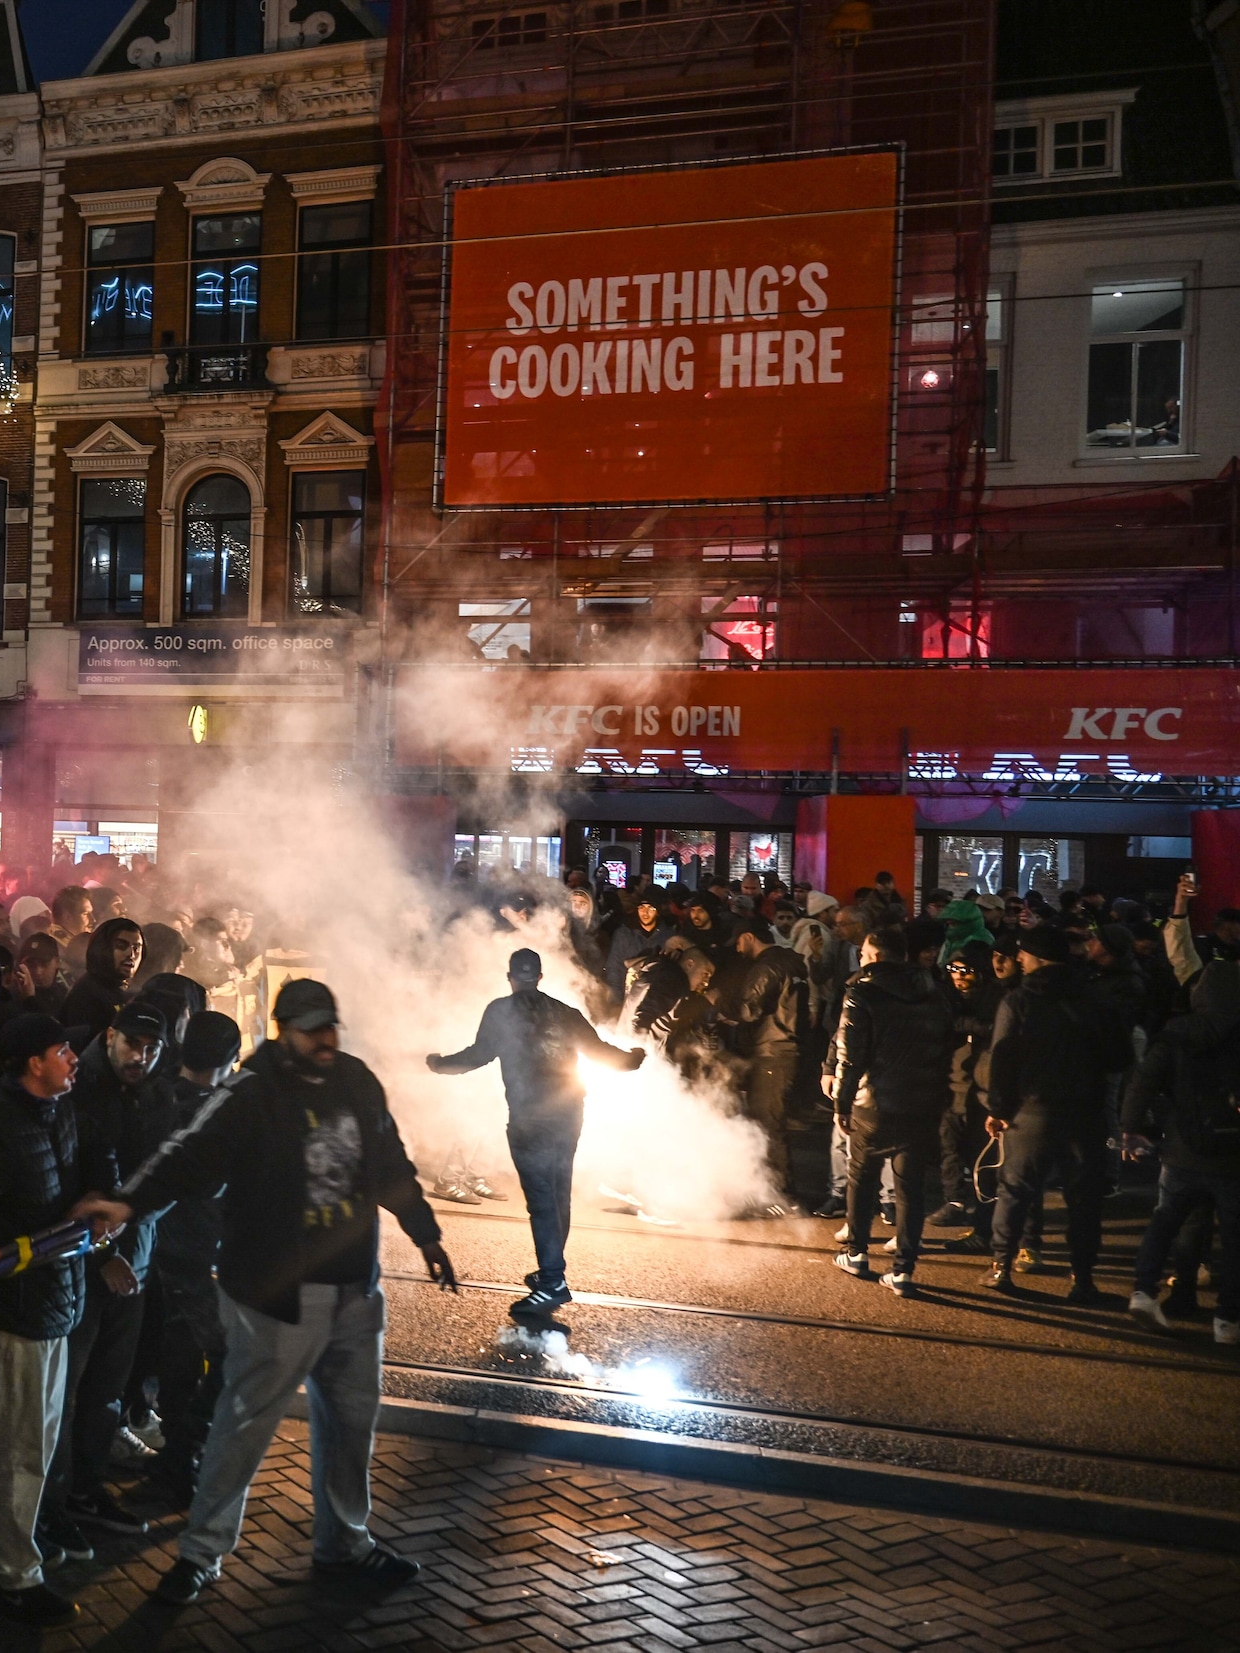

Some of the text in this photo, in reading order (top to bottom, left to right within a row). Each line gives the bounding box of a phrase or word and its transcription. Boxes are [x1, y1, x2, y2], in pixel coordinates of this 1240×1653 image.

[505, 262, 829, 335] SOMETHING'S
[489, 327, 845, 399] COOKING HERE
[87, 635, 334, 653] Approx. 500 sqm. office space
[87, 658, 181, 669] Units from 140 sqm.
[524, 705, 741, 736] KFC IS OPEN
[1063, 707, 1182, 741] KFC
